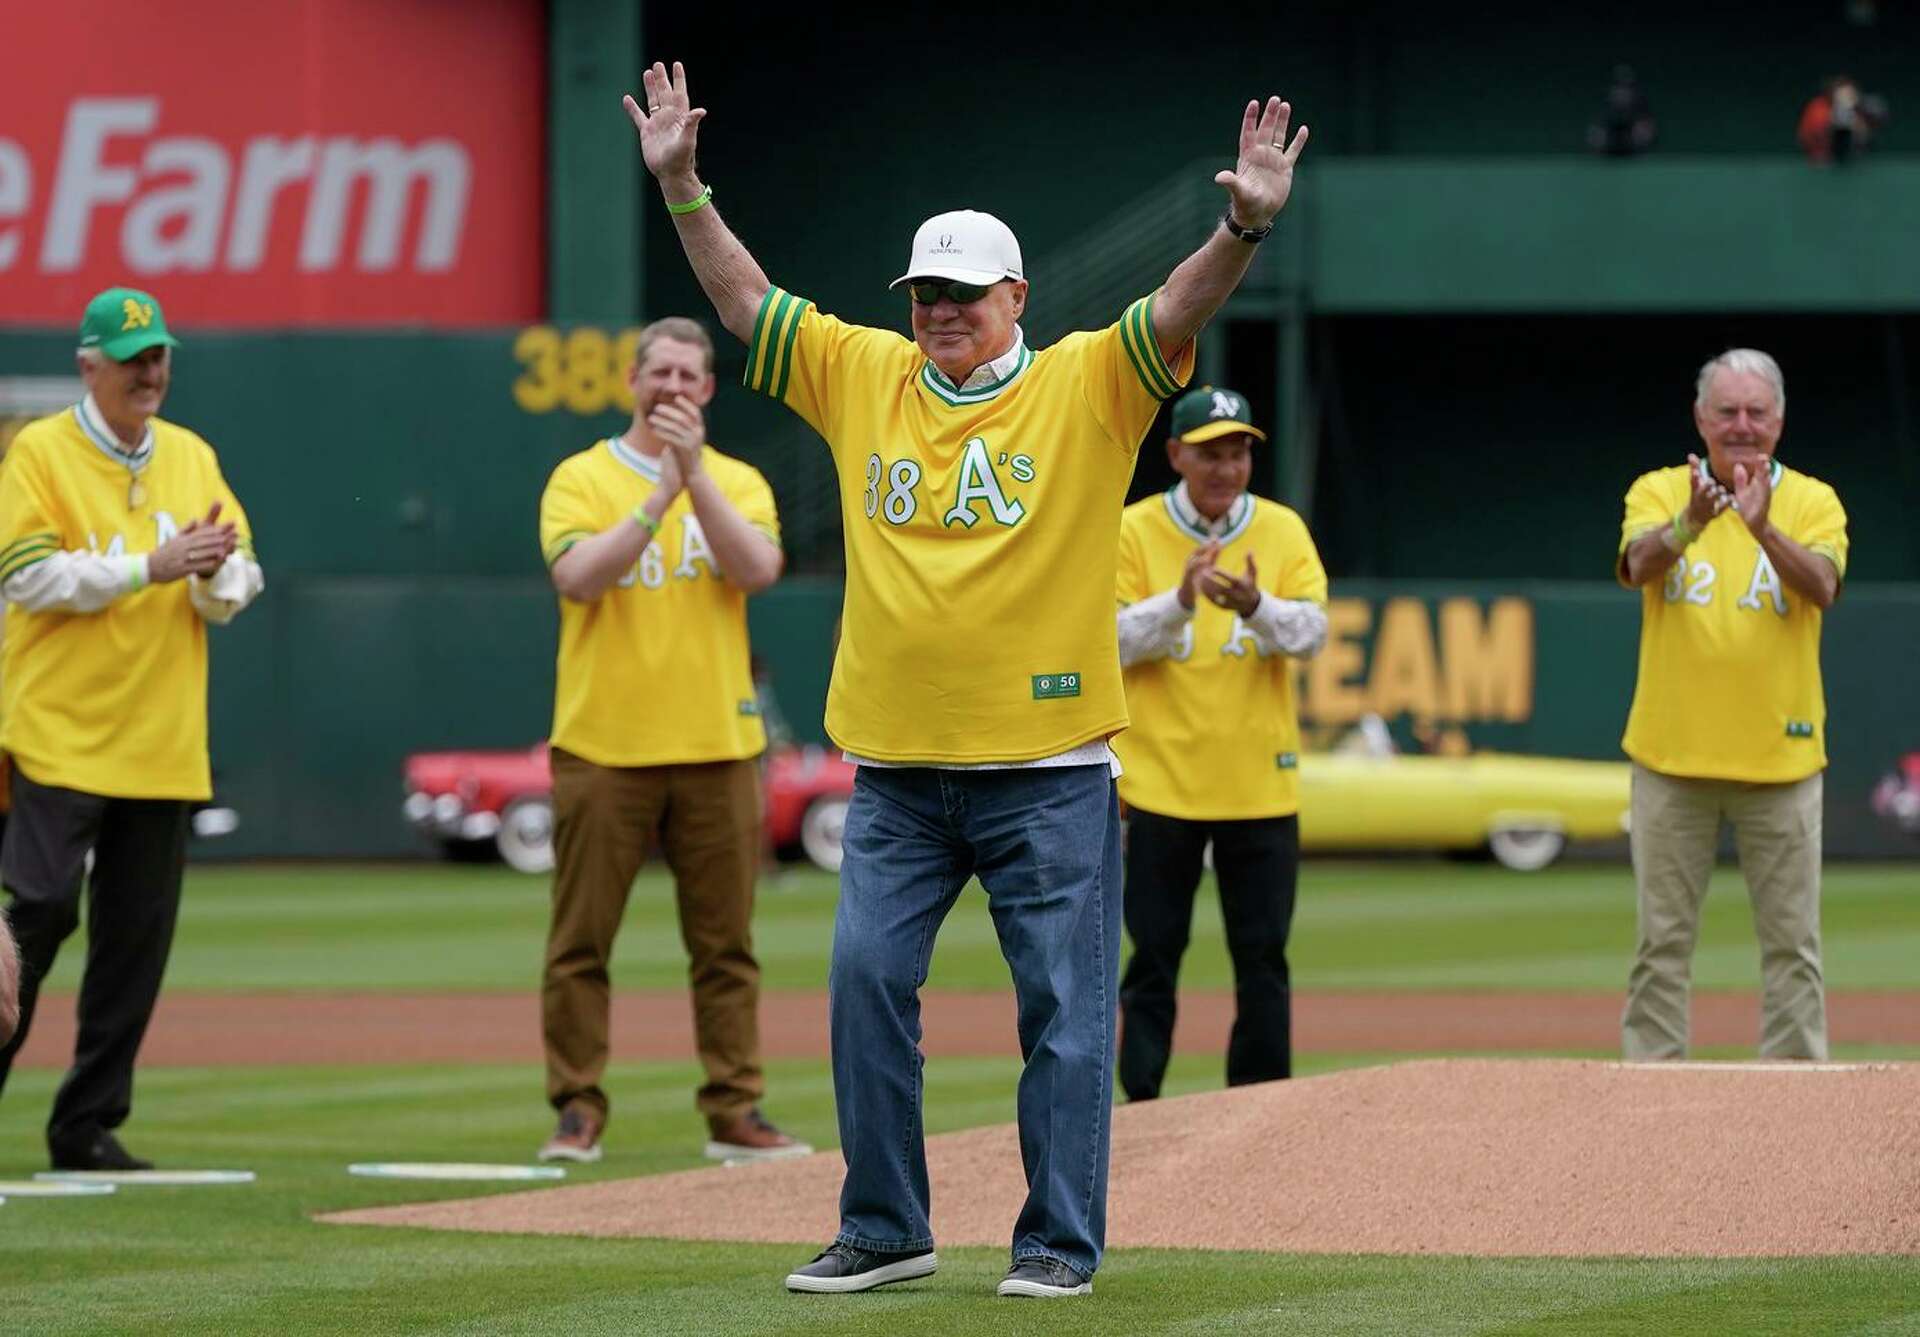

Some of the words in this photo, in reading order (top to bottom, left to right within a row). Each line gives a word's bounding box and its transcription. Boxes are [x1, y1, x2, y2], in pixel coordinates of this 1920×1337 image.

[39, 97, 471, 273] Farm
[864, 453, 921, 525] 38
[944, 437, 1036, 529] A's
[616, 540, 665, 589] 6
[1060, 675, 1076, 687] 50
[1306, 596, 1534, 723] EAM
